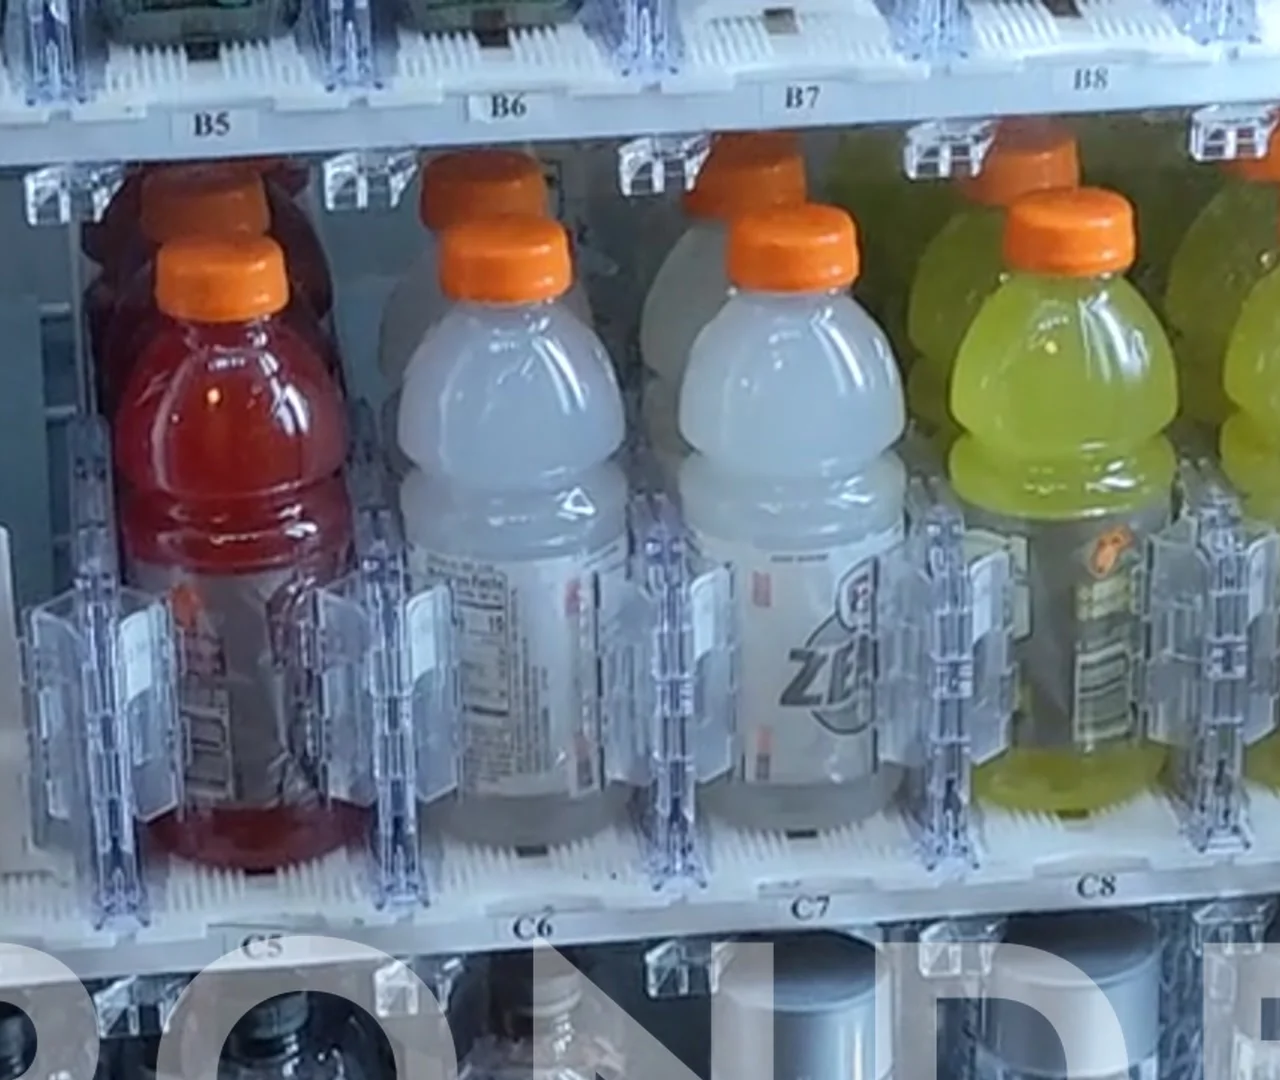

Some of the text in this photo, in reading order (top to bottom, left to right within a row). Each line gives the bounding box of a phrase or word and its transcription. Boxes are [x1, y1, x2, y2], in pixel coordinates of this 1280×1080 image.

[1073, 66, 1108, 92] B8
[491, 94, 527, 119] B6
[785, 85, 820, 111] B7
[193, 112, 231, 138] B5
[1076, 874, 1117, 899] C8
[790, 895, 830, 922] C7
[513, 914, 554, 940] C6
[241, 933, 283, 960] C5
